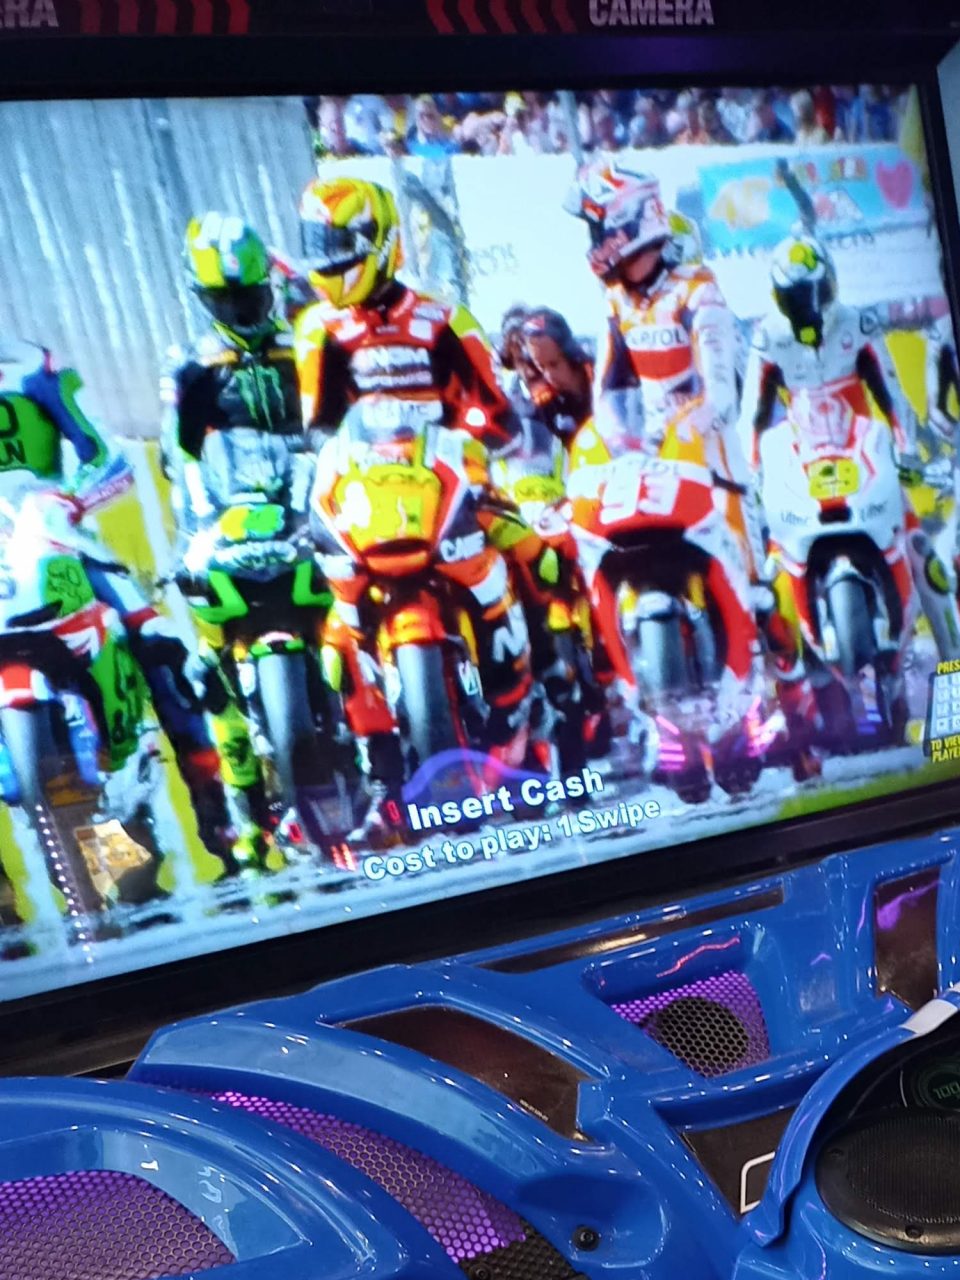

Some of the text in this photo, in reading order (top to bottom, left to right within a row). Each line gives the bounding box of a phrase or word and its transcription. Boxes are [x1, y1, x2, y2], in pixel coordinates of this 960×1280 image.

[589, 0, 715, 26] CAMERA
[931, 740, 943, 752] TO
[407, 767, 604, 830] Insert Cash
[363, 800, 662, 880] Cost to play: 1 Swipe
